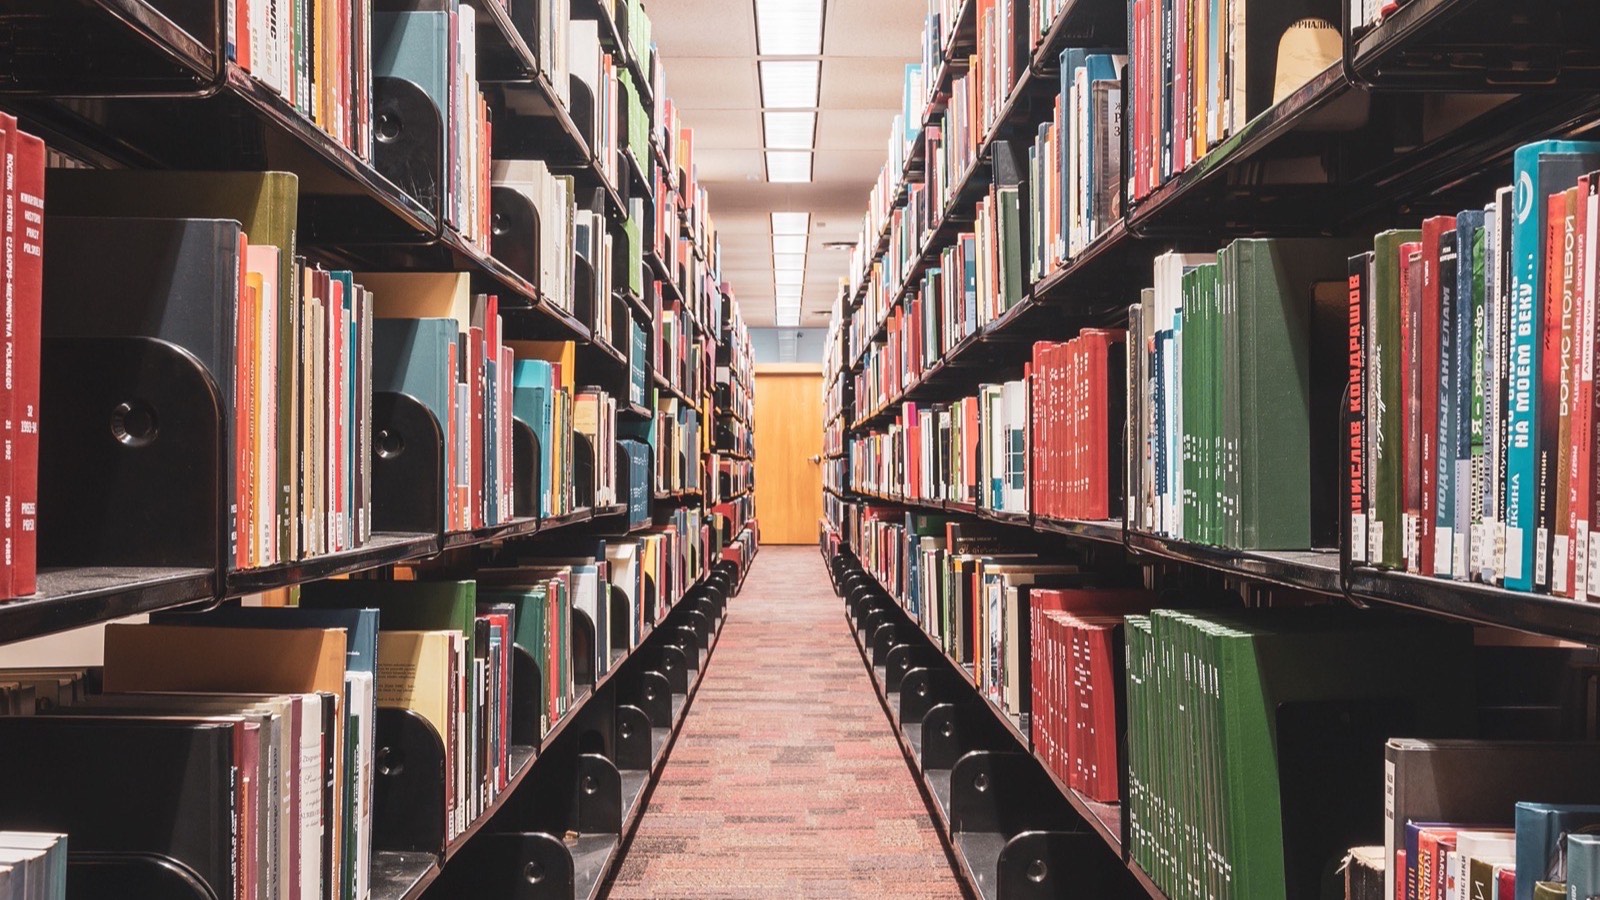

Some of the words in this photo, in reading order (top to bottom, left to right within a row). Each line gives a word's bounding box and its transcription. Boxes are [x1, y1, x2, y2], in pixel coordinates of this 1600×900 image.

[1563, 216, 1575, 330] ПОЛЕВОЙ
[1349, 274, 1361, 411] КОНДРАШОВ
[1440, 287, 1450, 389] АНГЕЛАМ
[1474, 304, 1484, 397] репортёр
[1515, 344, 1531, 412] МОЕМ
[1559, 336, 1571, 416] БОРИС
[1584, 340, 1592, 375] Anna
[1438, 393, 1450, 518] ПОДОБНЫЕ
[1472, 419, 1482, 436] Я
[1499, 418, 1507, 478] Мукусев
[1514, 420, 1529, 448] НА
